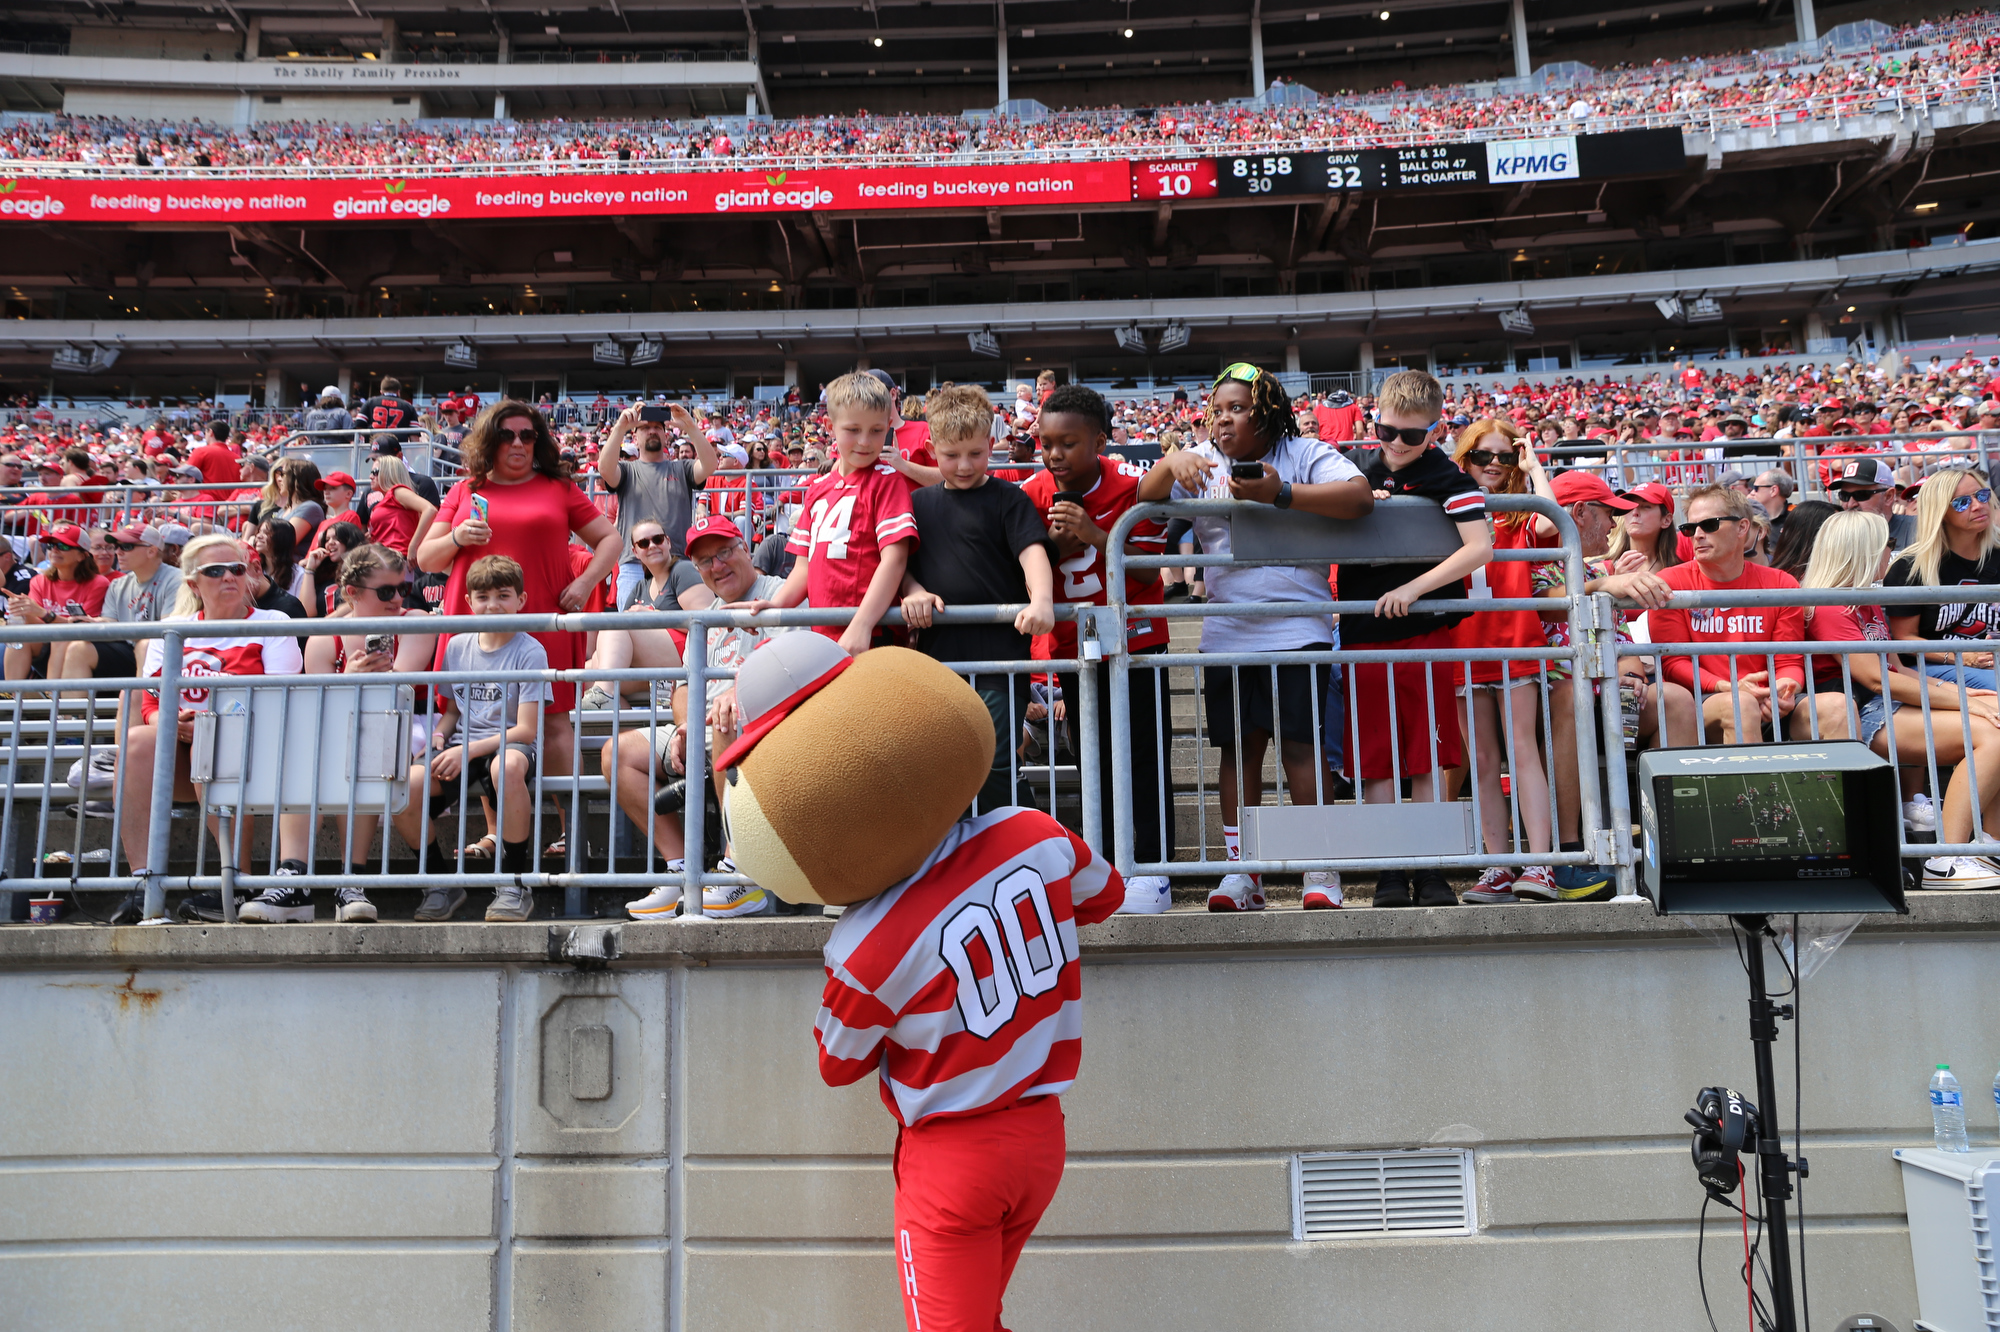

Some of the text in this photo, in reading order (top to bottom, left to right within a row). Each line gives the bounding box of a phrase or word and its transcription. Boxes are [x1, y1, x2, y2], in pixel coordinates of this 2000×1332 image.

[274, 67, 461, 79] The Shelly Family Pressbox
[1327, 154, 1359, 165] GRAY
[1398, 148, 1447, 160] 1st & 10
[1149, 162, 1198, 173] SCARLET
[1233, 157, 1292, 177] 8:58
[1400, 159, 1467, 172] BALL ON 47
[1495, 153, 1567, 176] KPMG
[1158, 174, 1191, 196] 10
[1248, 177, 1272, 192] 30
[1327, 166, 1362, 189] 32
[1400, 170, 1477, 184] 3rd QUARTER
[858, 177, 1074, 198] feeding buckeye nation
[1, 195, 65, 219] eagle
[90, 194, 307, 213] feeding buckeye nation
[333, 194, 451, 219] giant eagle
[475, 188, 688, 208] feeding buckeye nation
[715, 186, 833, 211] giant eagle
[372, 407, 404, 428] 97
[939, 864, 1067, 1041] 00
[900, 1229, 921, 1332] OHI
